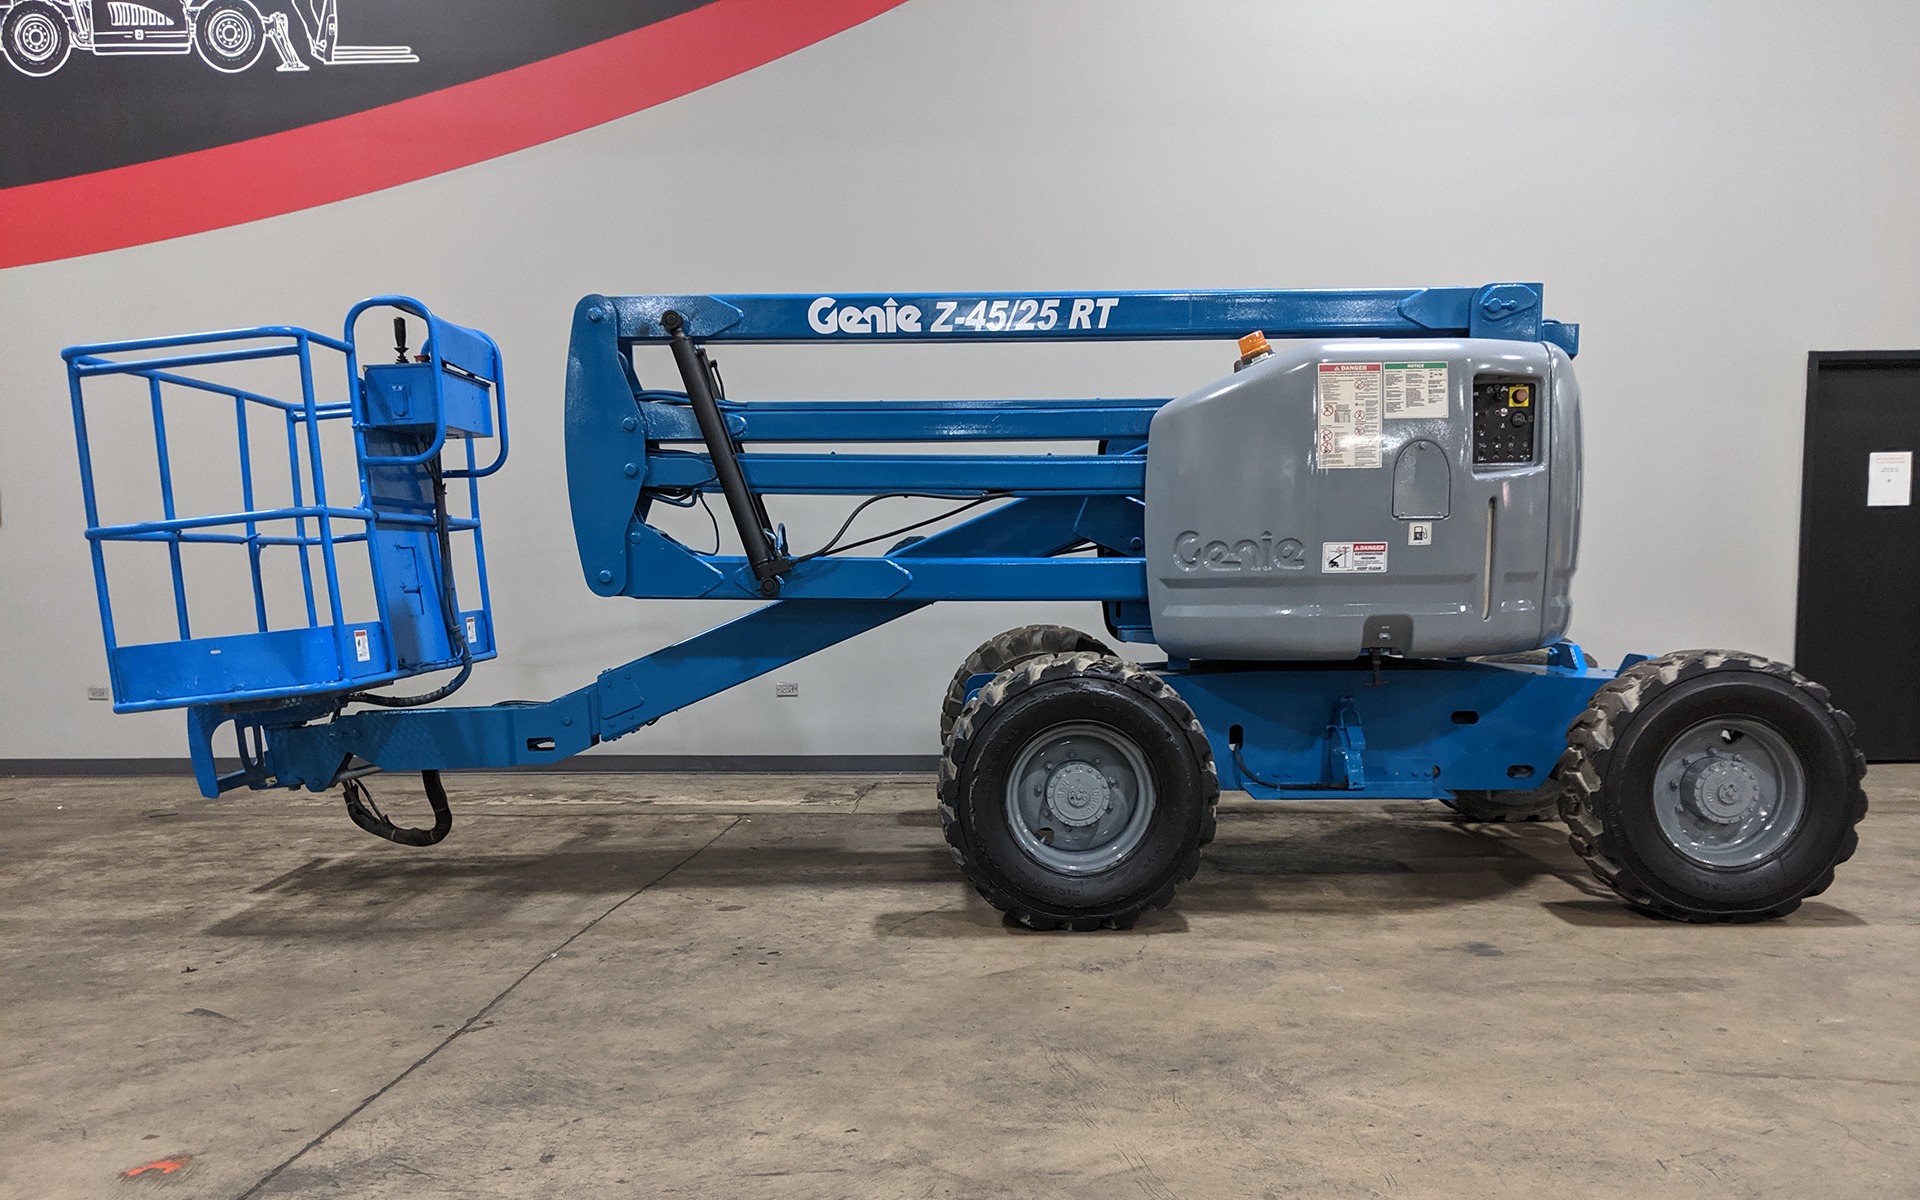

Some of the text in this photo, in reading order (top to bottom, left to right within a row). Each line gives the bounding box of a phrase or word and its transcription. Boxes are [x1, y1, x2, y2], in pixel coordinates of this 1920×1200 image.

[808, 297, 1119, 334] Genie Z-45/25 RT
[1173, 530, 1305, 571] Genie
